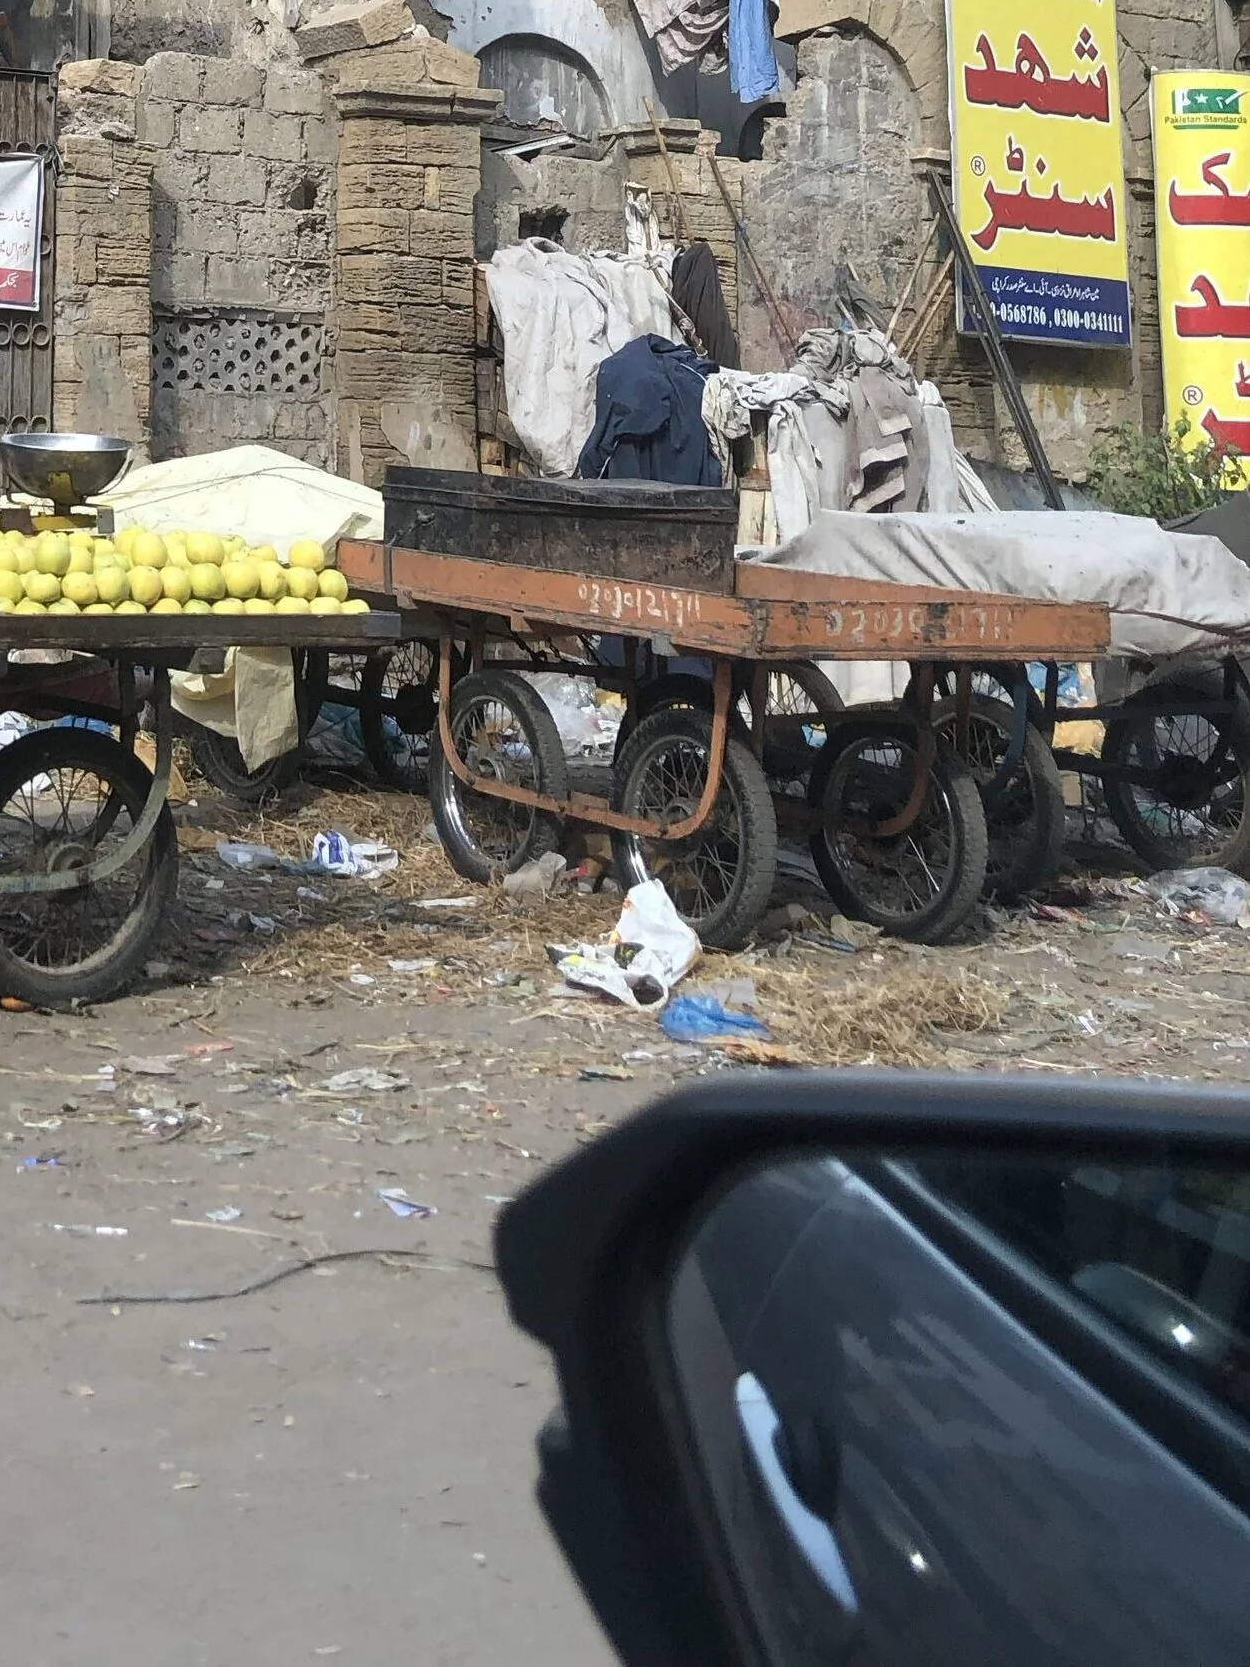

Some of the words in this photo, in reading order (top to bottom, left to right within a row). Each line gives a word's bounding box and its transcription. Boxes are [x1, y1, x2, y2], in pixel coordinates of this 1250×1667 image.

[1164, 115, 1201, 124] Pakistan
[1203, 114, 1248, 125] Standards
[970, 135, 1116, 251] سنٹر
[1054, 308, 1124, 333] 0300-0341111
